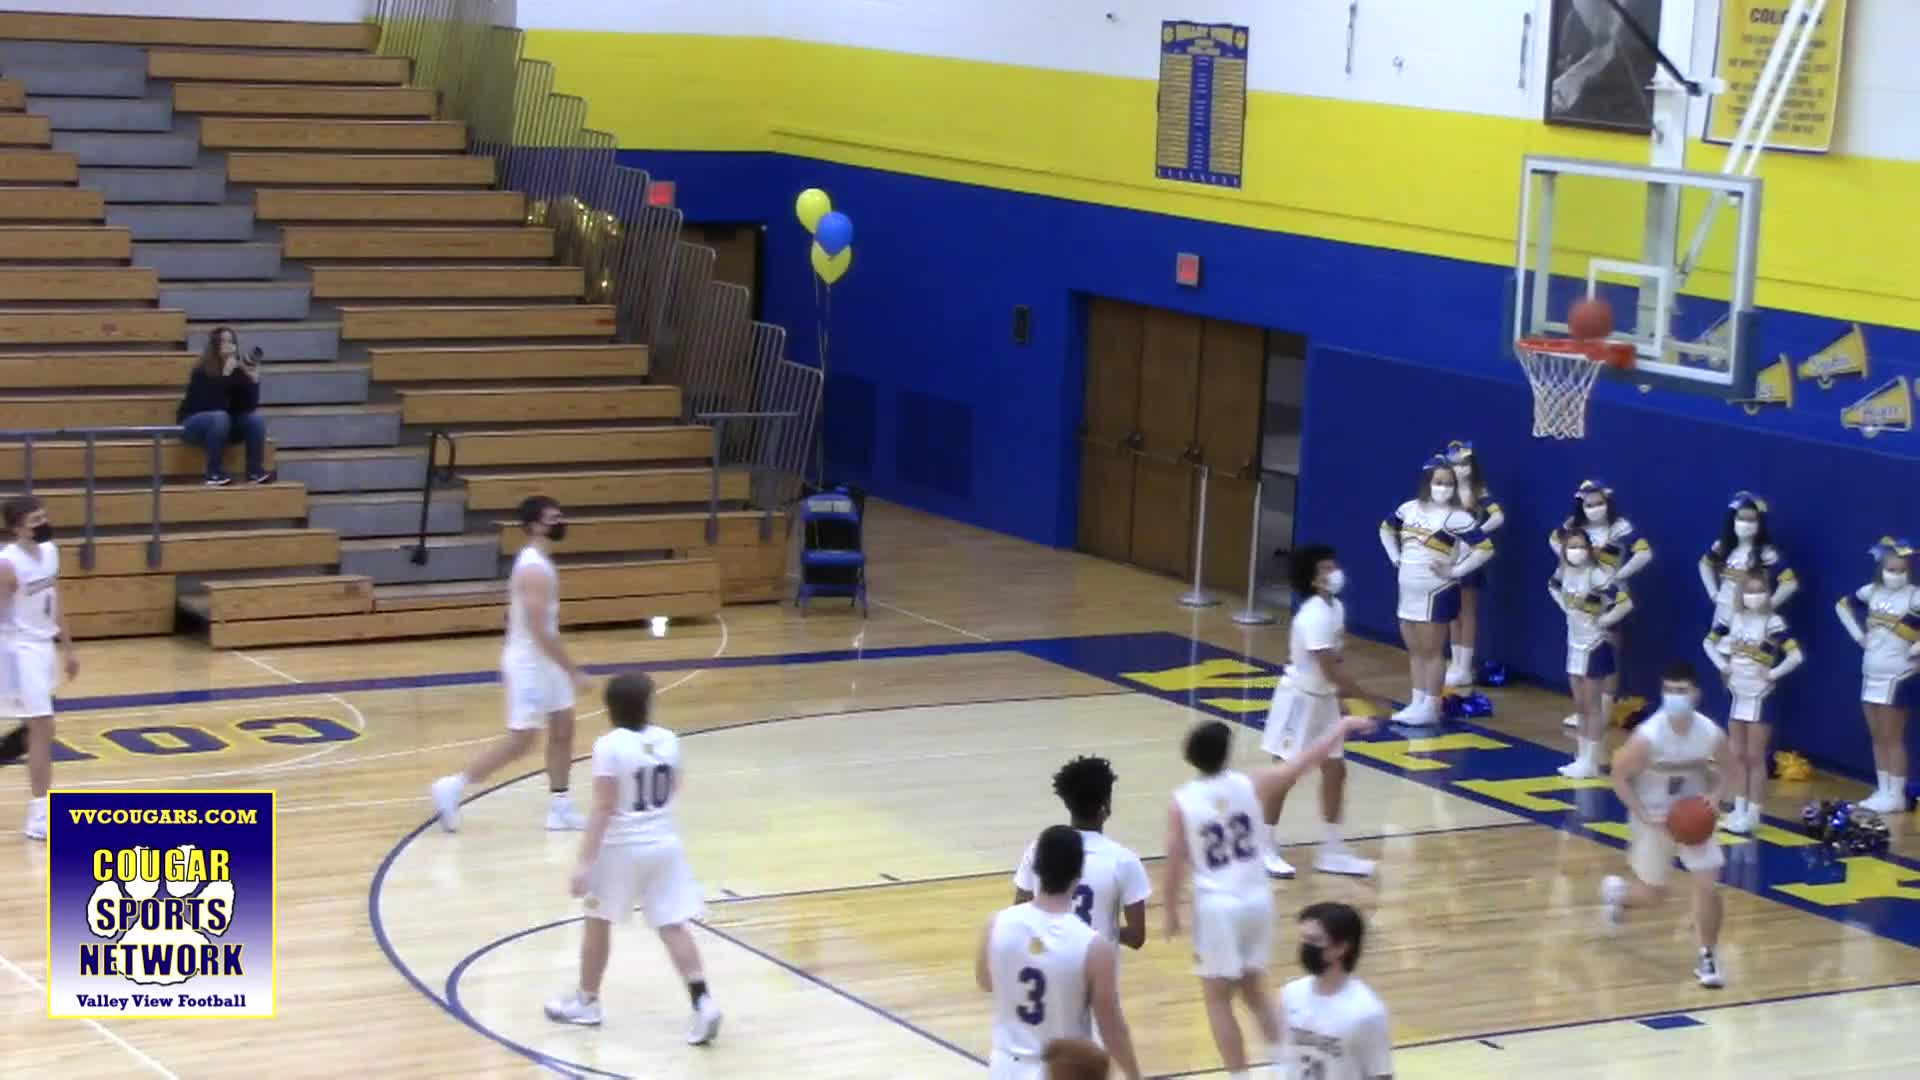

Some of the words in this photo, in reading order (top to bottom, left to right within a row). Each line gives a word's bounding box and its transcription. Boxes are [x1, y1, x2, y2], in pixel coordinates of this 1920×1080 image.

[632, 764, 672, 811] 10
[1199, 812, 1257, 869] 22
[1015, 966, 1047, 1025] 3
